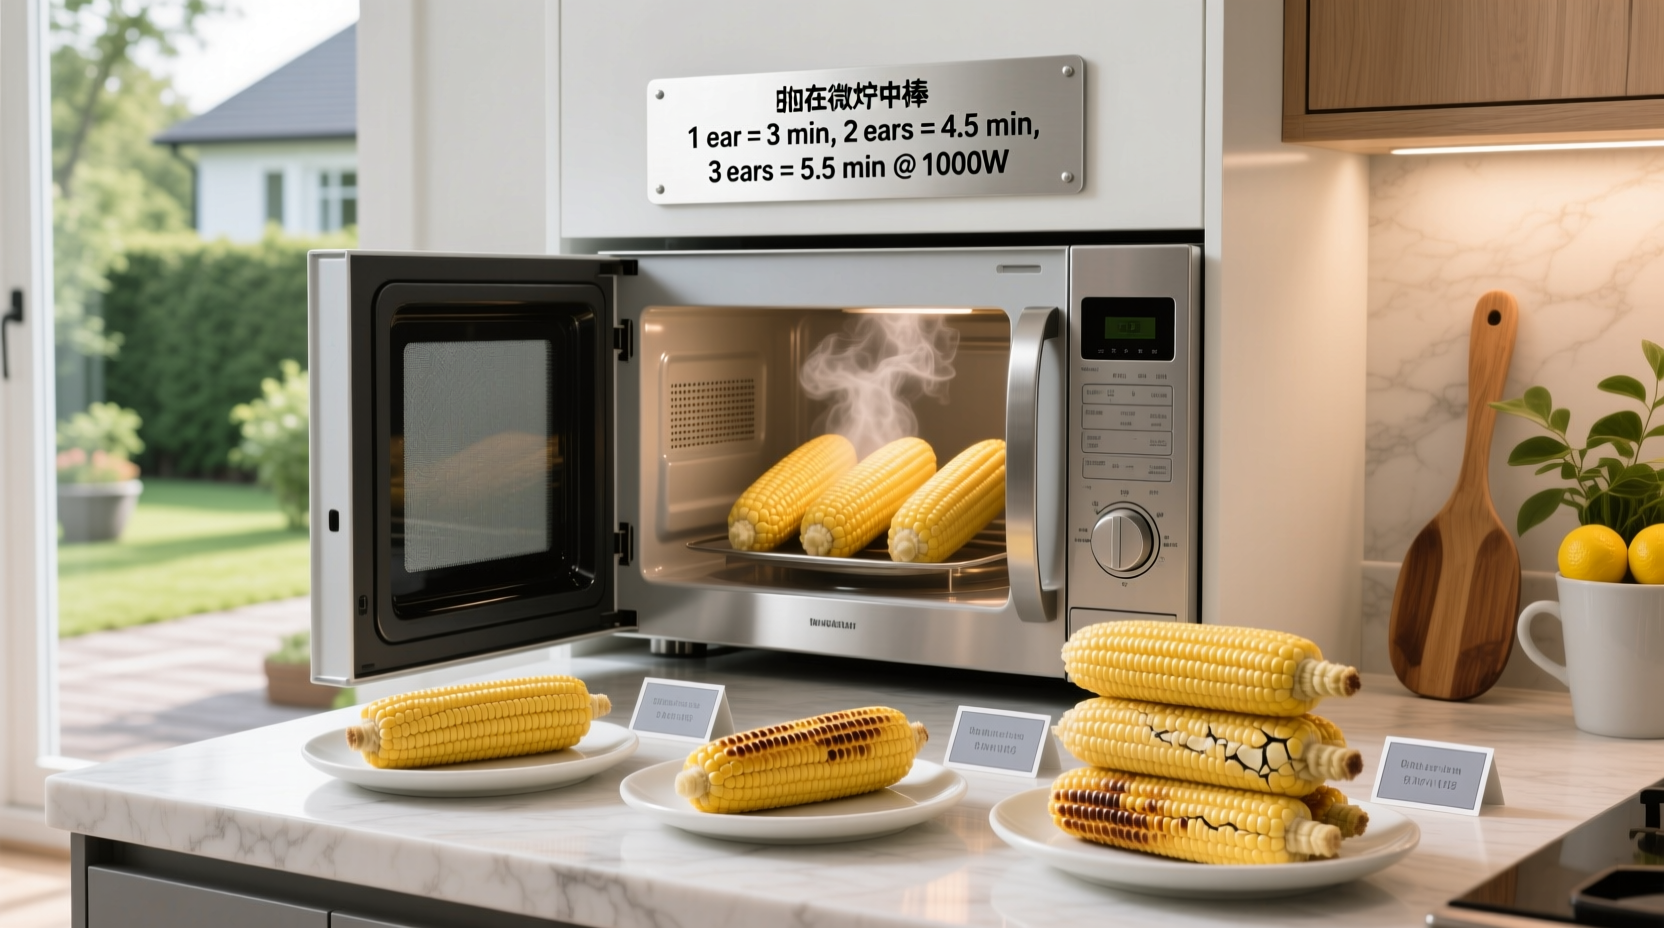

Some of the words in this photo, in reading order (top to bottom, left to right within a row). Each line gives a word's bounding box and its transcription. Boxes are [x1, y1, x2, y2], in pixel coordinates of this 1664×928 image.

[688, 127, 698, 149] 1
[707, 130, 742, 148] ear
[747, 130, 761, 142] =
[767, 122, 780, 146] 3
[787, 120, 837, 149] min,
[843, 119, 858, 143] 2
[864, 122, 914, 142] ears
[920, 122, 936, 136] =
[941, 113, 979, 138] 4.5
[987, 110, 1040, 140] min,
[708, 160, 722, 183] 3
[727, 164, 774, 183] ears
[780, 165, 794, 177] =
[801, 157, 836, 181] 5.5
[843, 154, 886, 179] min
[894, 153, 917, 180] @
[923, 148, 1010, 176] 1000W
